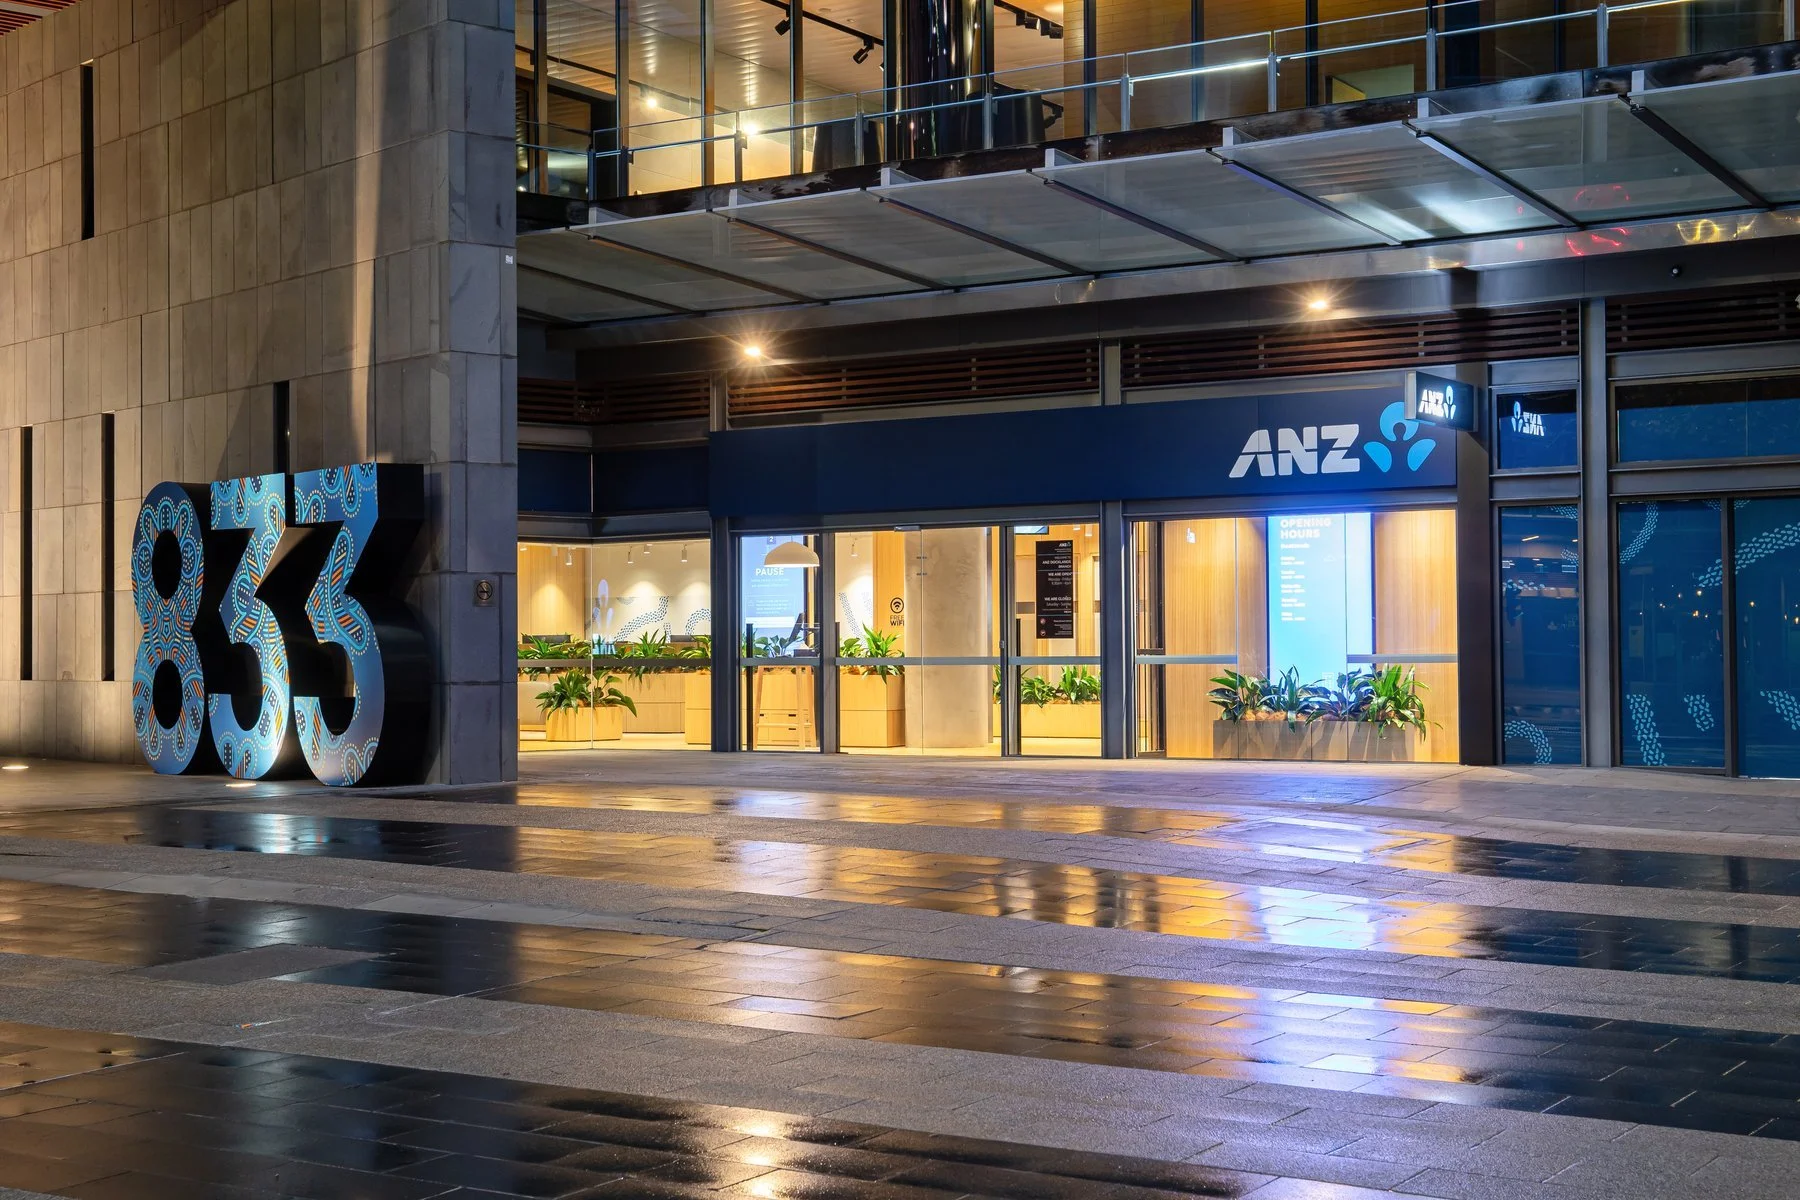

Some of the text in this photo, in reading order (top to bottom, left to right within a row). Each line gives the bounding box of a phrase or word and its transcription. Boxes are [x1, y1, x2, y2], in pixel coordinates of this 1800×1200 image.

[1418, 388, 1445, 418] ANZ
[1228, 423, 1361, 478] ANZ
[1280, 517, 1332, 528] OPENING
[1280, 528, 1321, 539] HOURS
[755, 567, 785, 577] PAUSE
[131, 461, 385, 787] 833
